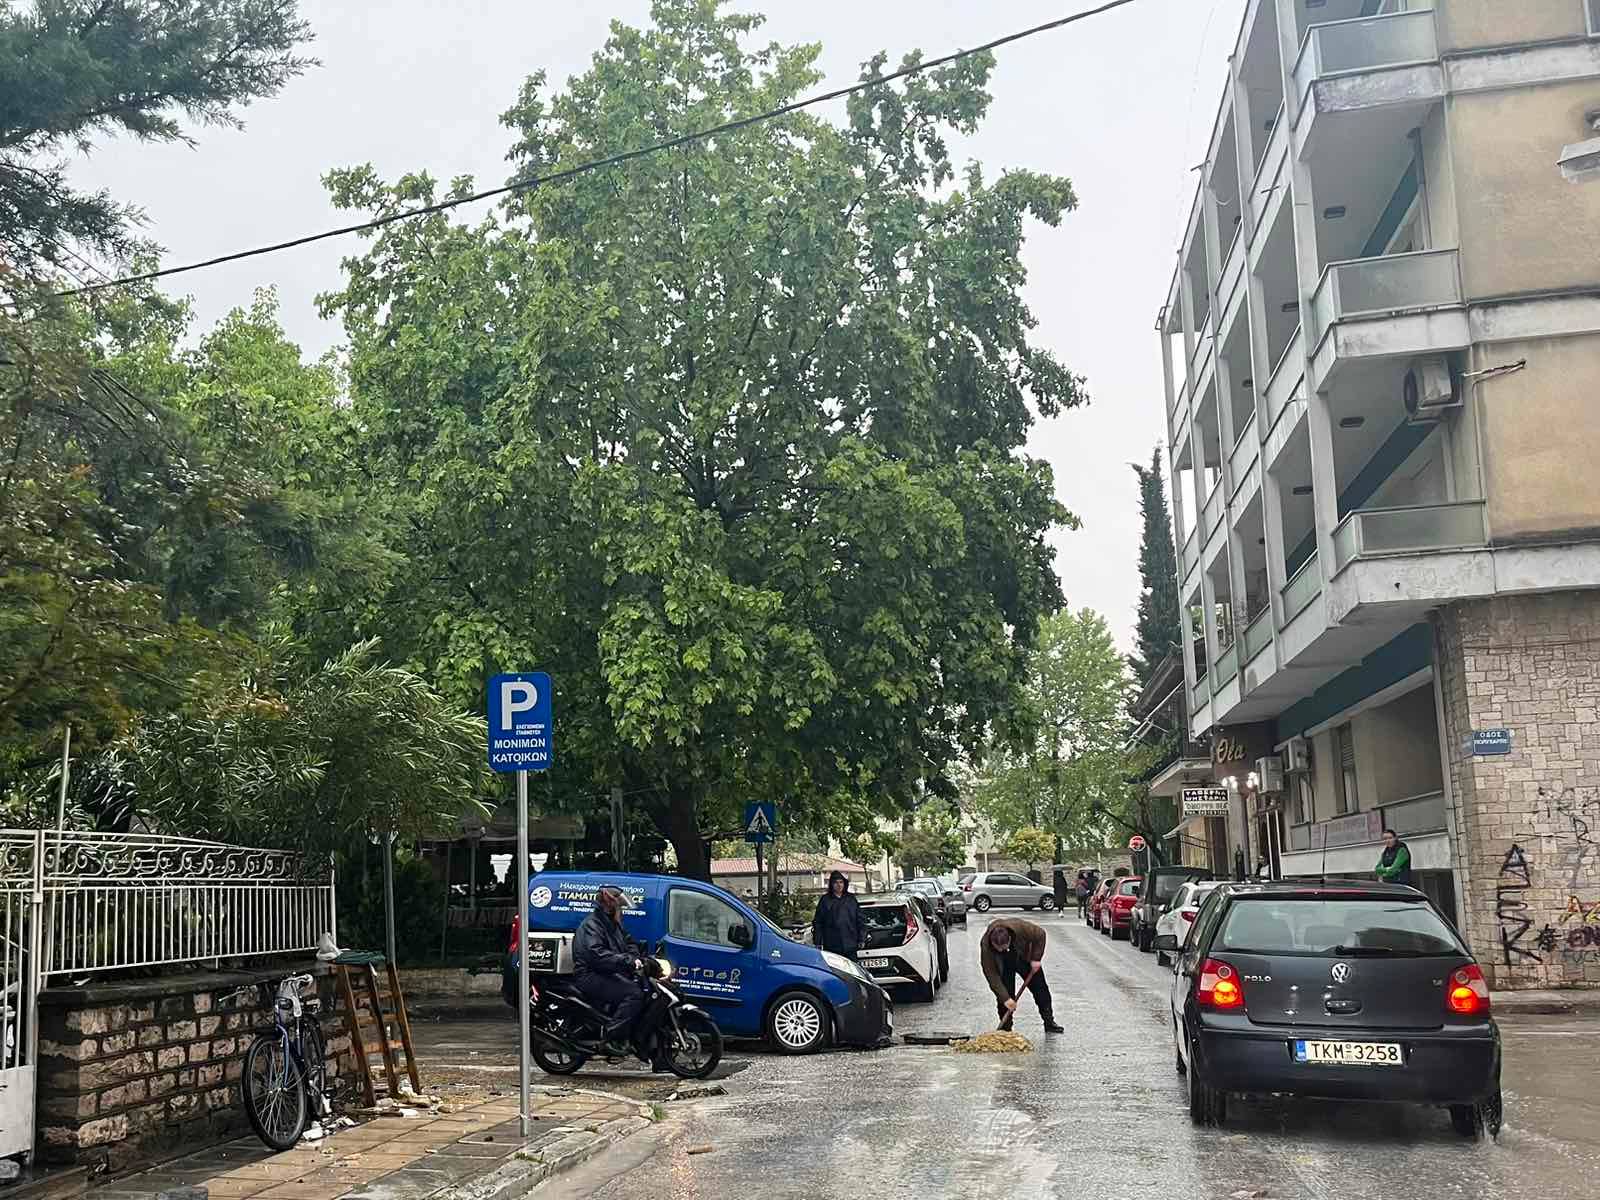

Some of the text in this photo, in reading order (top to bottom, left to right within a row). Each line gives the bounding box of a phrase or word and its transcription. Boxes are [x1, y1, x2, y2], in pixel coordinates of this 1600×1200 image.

[501, 682, 538, 730] P
[494, 738, 546, 749] ΜΟΝΙΜΩΝ
[492, 752, 547, 763] ΚΑΤΟΙΚΩΝ
